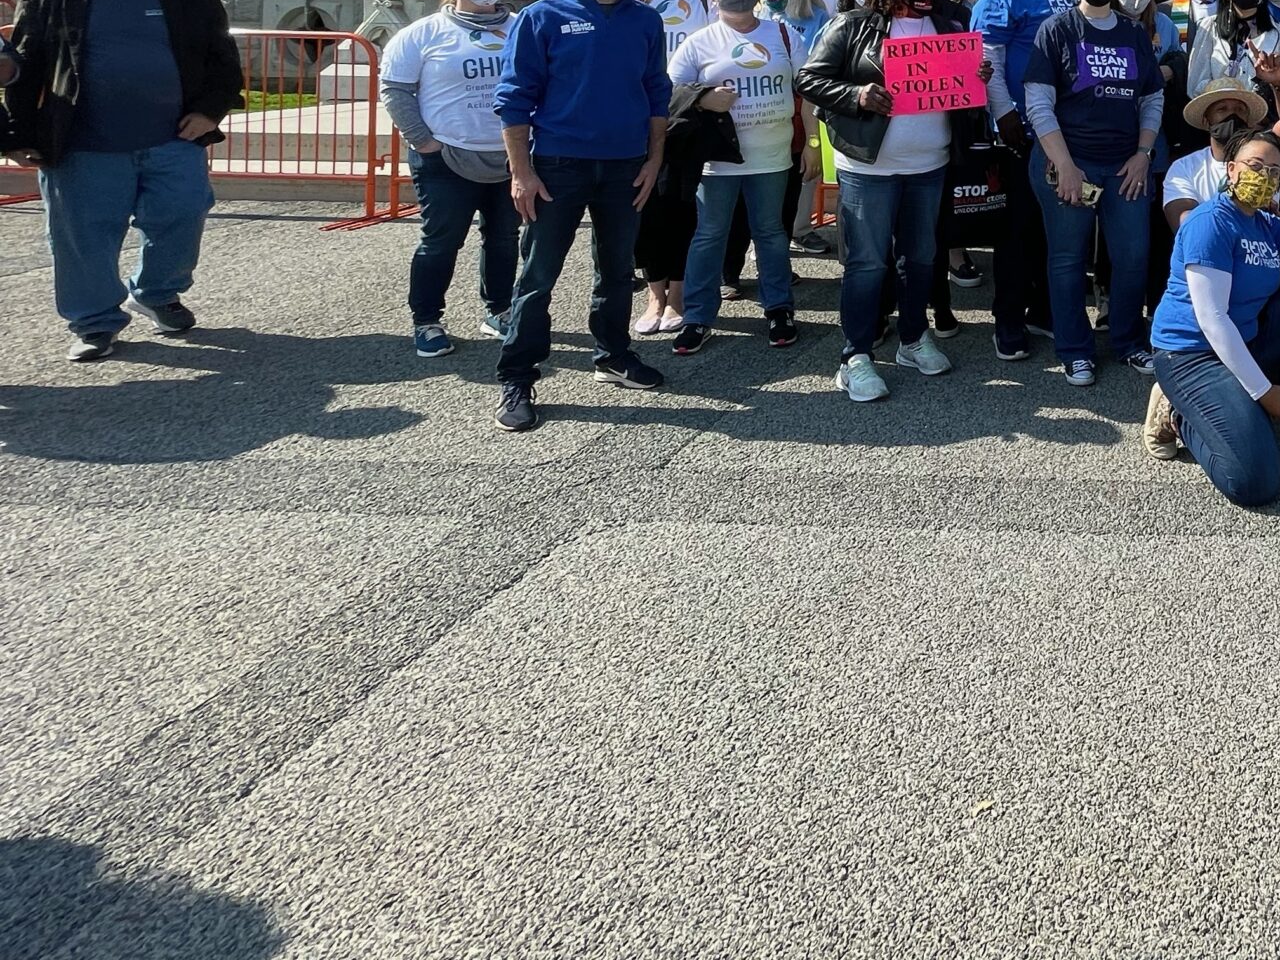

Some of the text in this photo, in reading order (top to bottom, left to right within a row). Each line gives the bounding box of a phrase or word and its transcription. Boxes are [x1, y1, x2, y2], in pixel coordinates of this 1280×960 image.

[887, 39, 978, 58] REINVEST
[1094, 46, 1117, 55] PASS
[1086, 55, 1128, 68] CLEAN
[907, 62, 928, 77] IN
[1091, 66, 1126, 79] SLATE
[891, 75, 964, 95] STOLEN
[918, 93, 971, 111] LIVES
[953, 185, 989, 198] STOP
